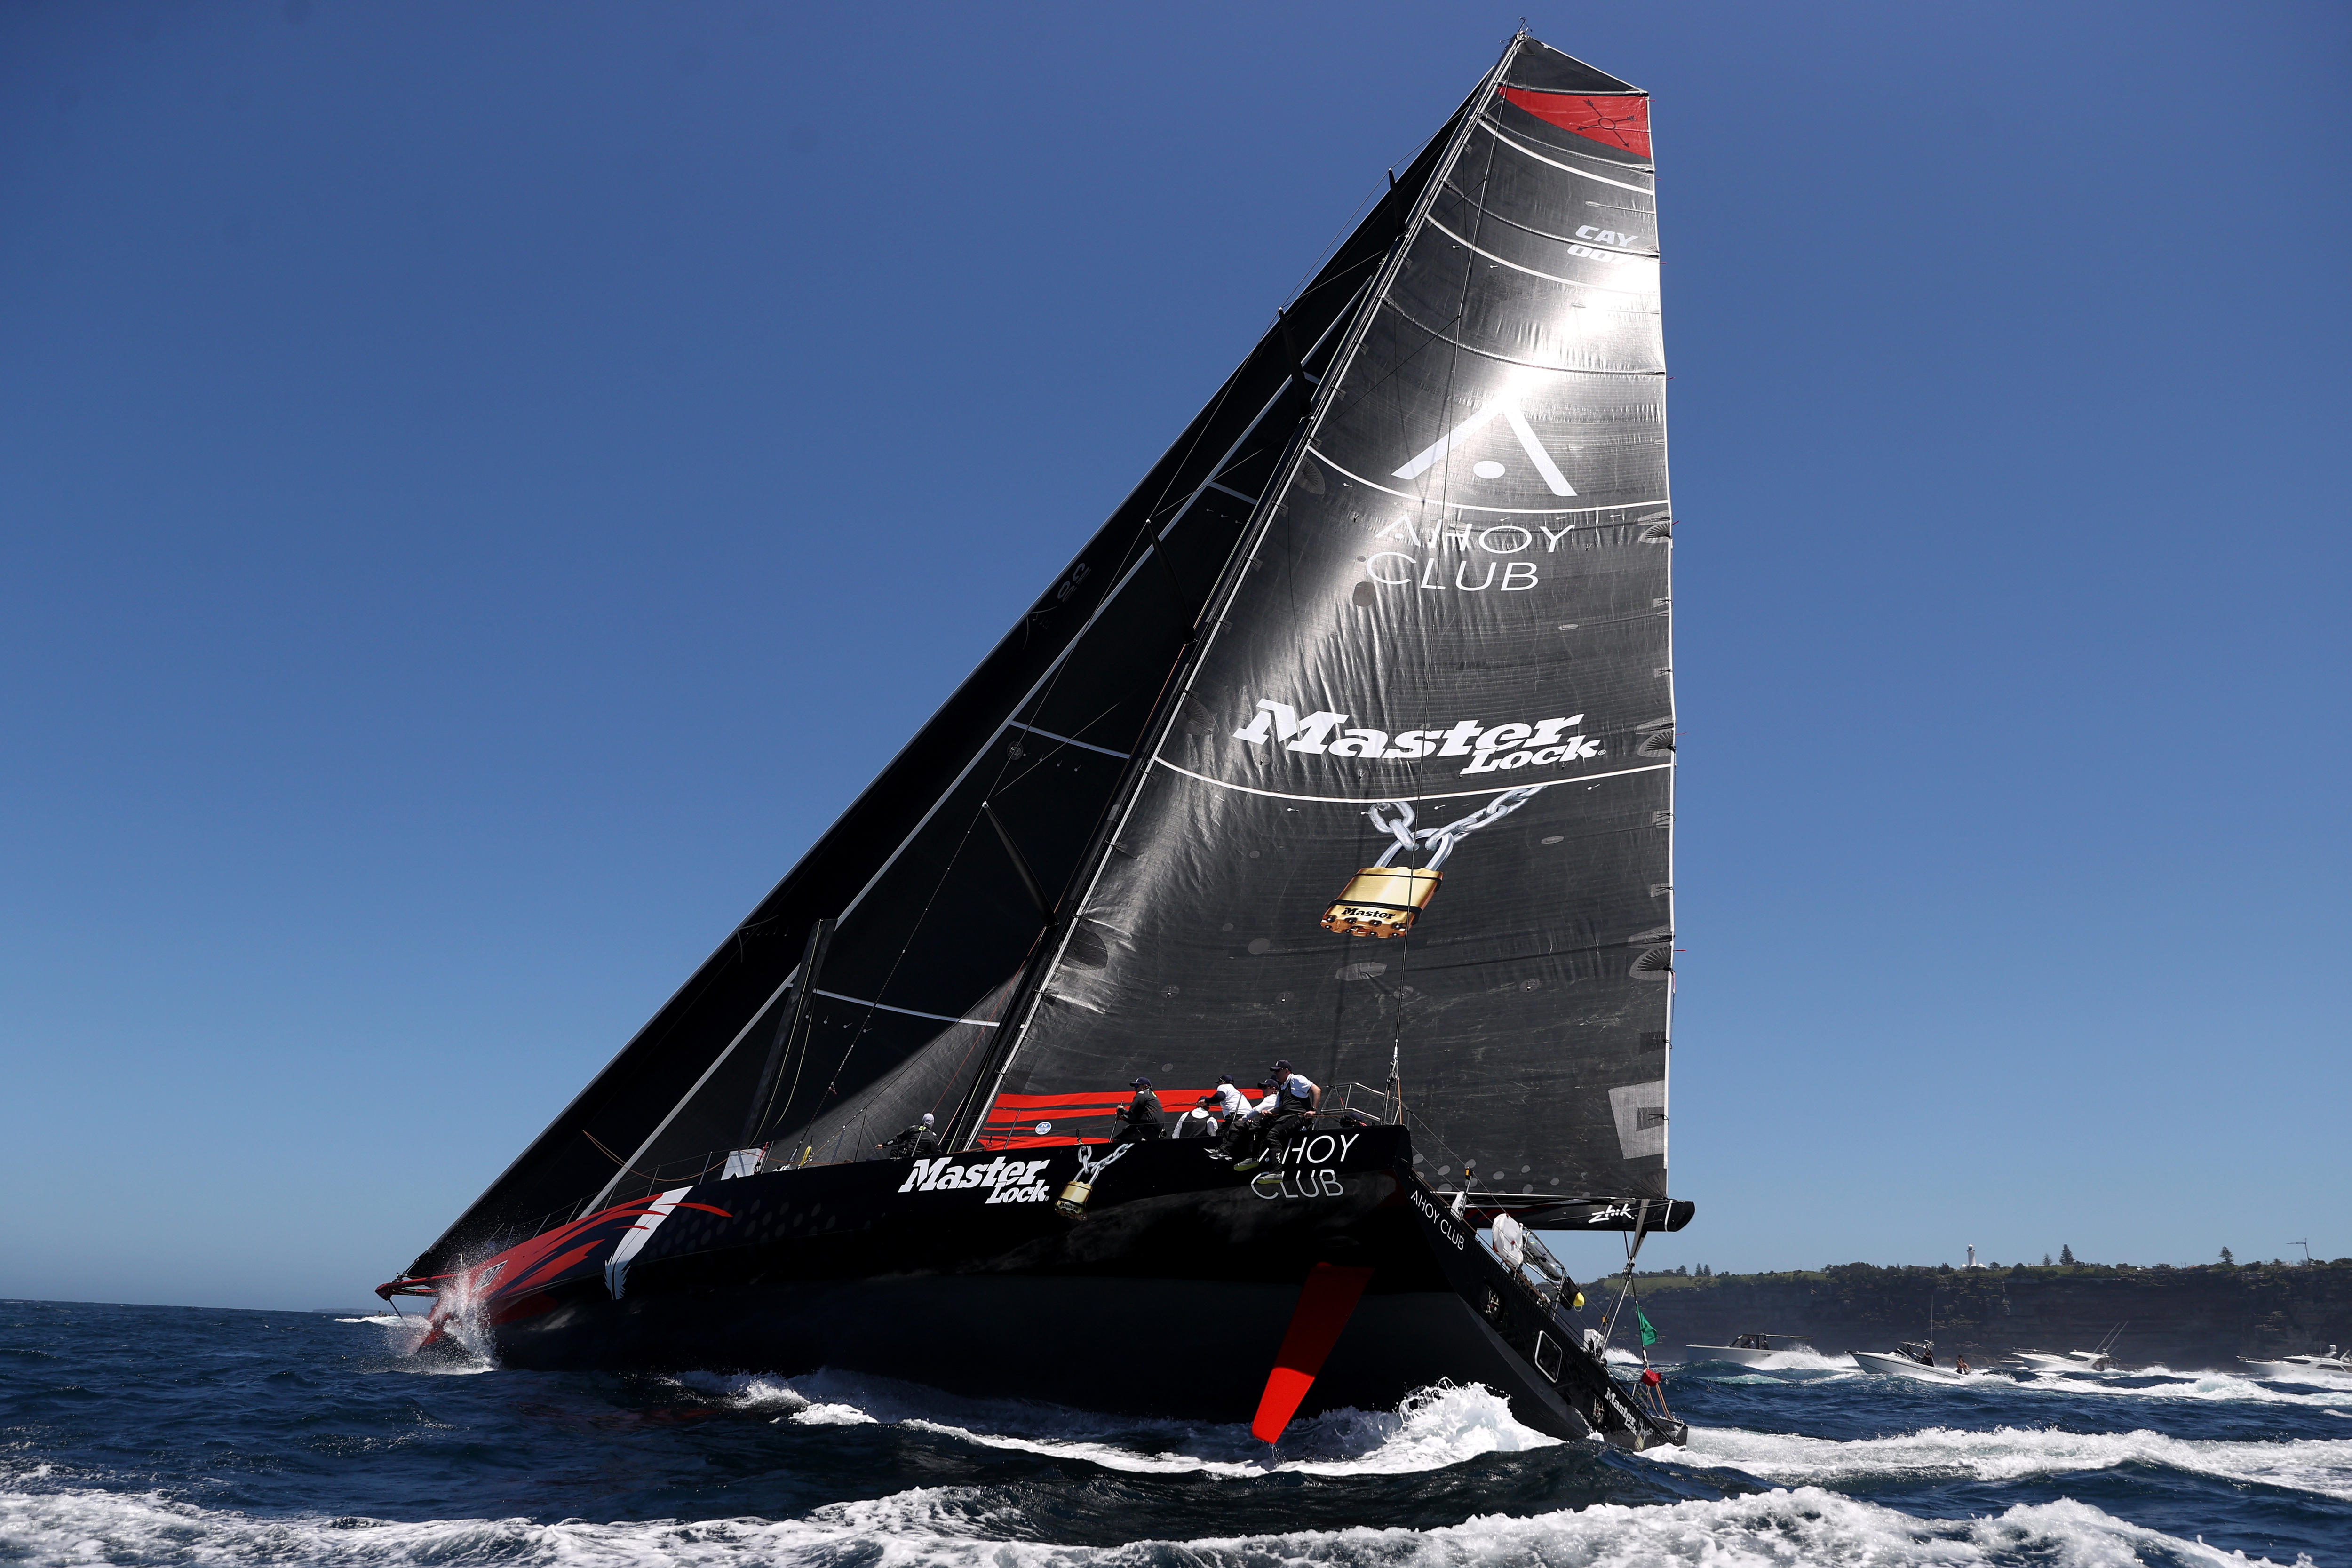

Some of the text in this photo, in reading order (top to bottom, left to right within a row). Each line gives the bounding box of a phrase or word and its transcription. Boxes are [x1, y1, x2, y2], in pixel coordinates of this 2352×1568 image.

[1575, 225, 1638, 247] CAY
[1374, 513, 1575, 554] AHOY
[1366, 551, 1539, 591] CLUB
[1232, 699, 1584, 758] Master
[1341, 907, 1396, 919] Master
[898, 1156, 1051, 1193] Master
[1251, 1169, 1344, 1200] CLUB
[1410, 1190, 1464, 1250] AHOY CLUB
[1605, 1387, 1636, 1426] Master
